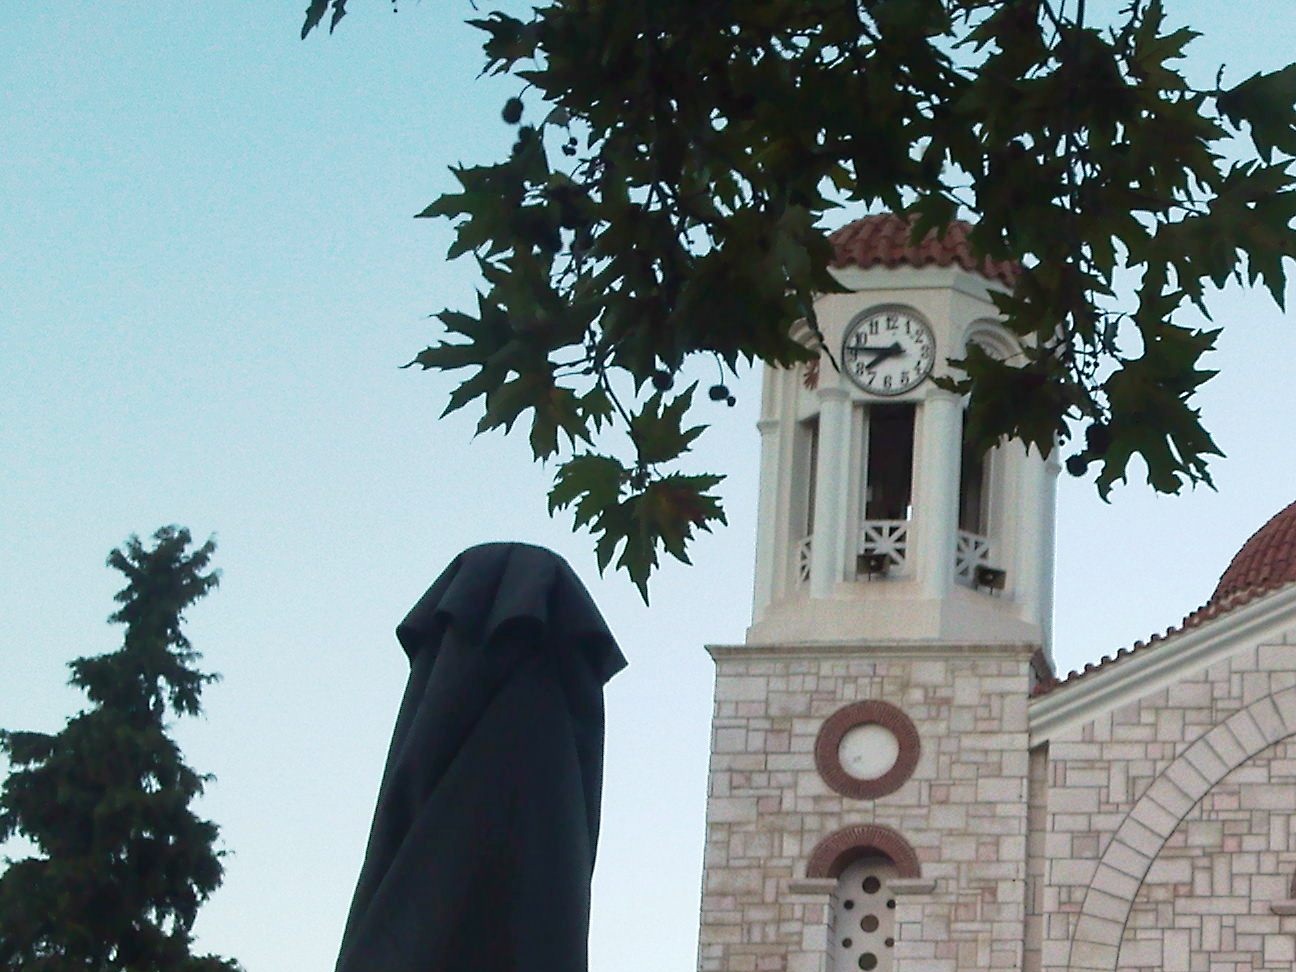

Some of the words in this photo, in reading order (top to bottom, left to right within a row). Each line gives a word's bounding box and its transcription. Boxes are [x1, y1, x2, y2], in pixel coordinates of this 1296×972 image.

[869, 320, 878, 334] 11
[886, 313, 899, 330] 12
[856, 332, 868, 347] 10
[914, 329, 924, 344] 2
[921, 344, 929, 359] 3
[867, 371, 877, 386] 7
[883, 374, 892, 389] 6
